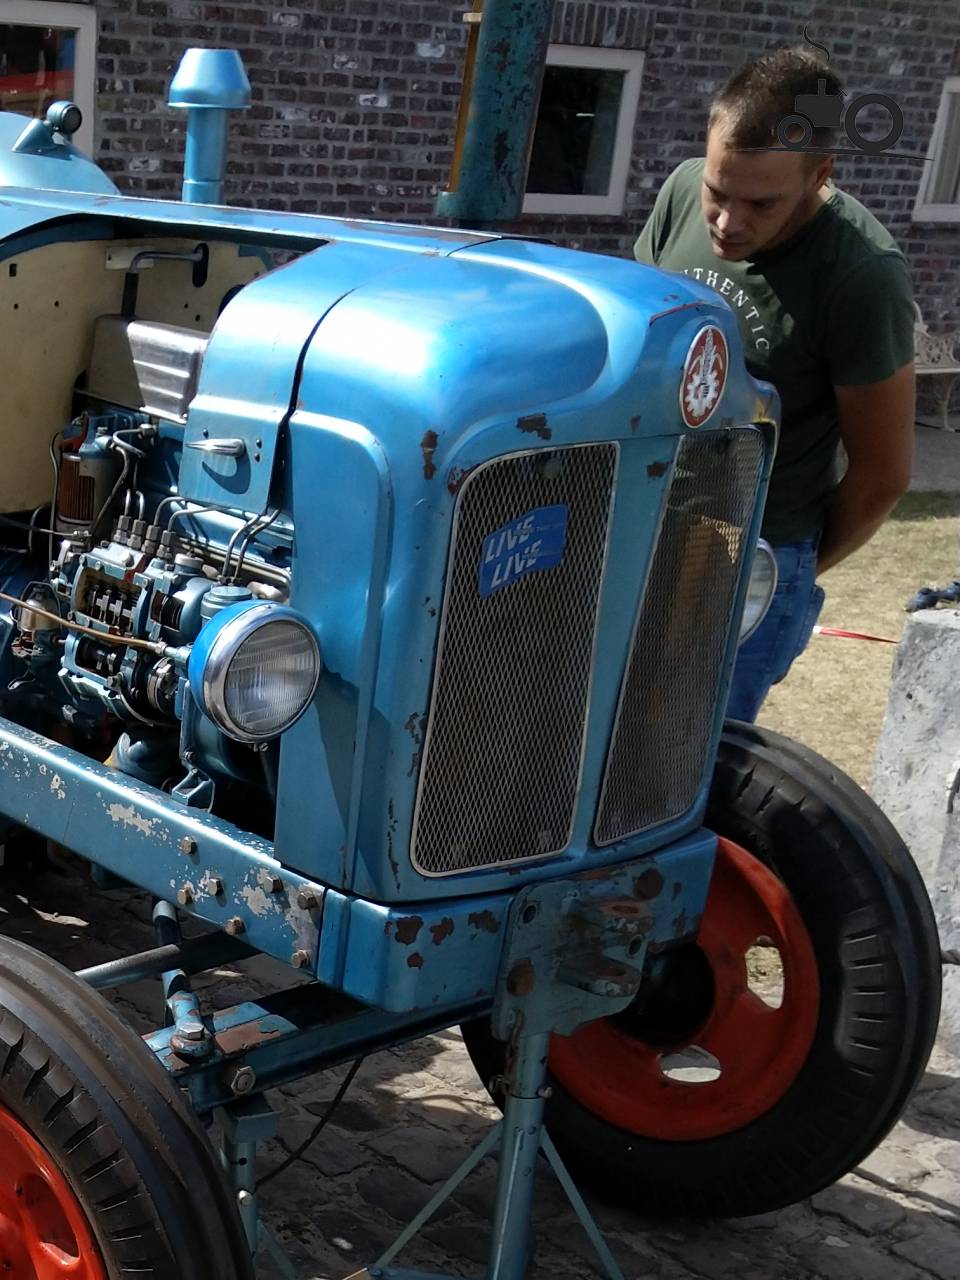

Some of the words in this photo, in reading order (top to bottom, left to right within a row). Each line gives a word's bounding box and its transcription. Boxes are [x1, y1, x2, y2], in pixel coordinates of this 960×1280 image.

[680, 268, 770, 351] THENTIC
[485, 515, 535, 563] LIVE
[491, 539, 542, 588] LIVE
